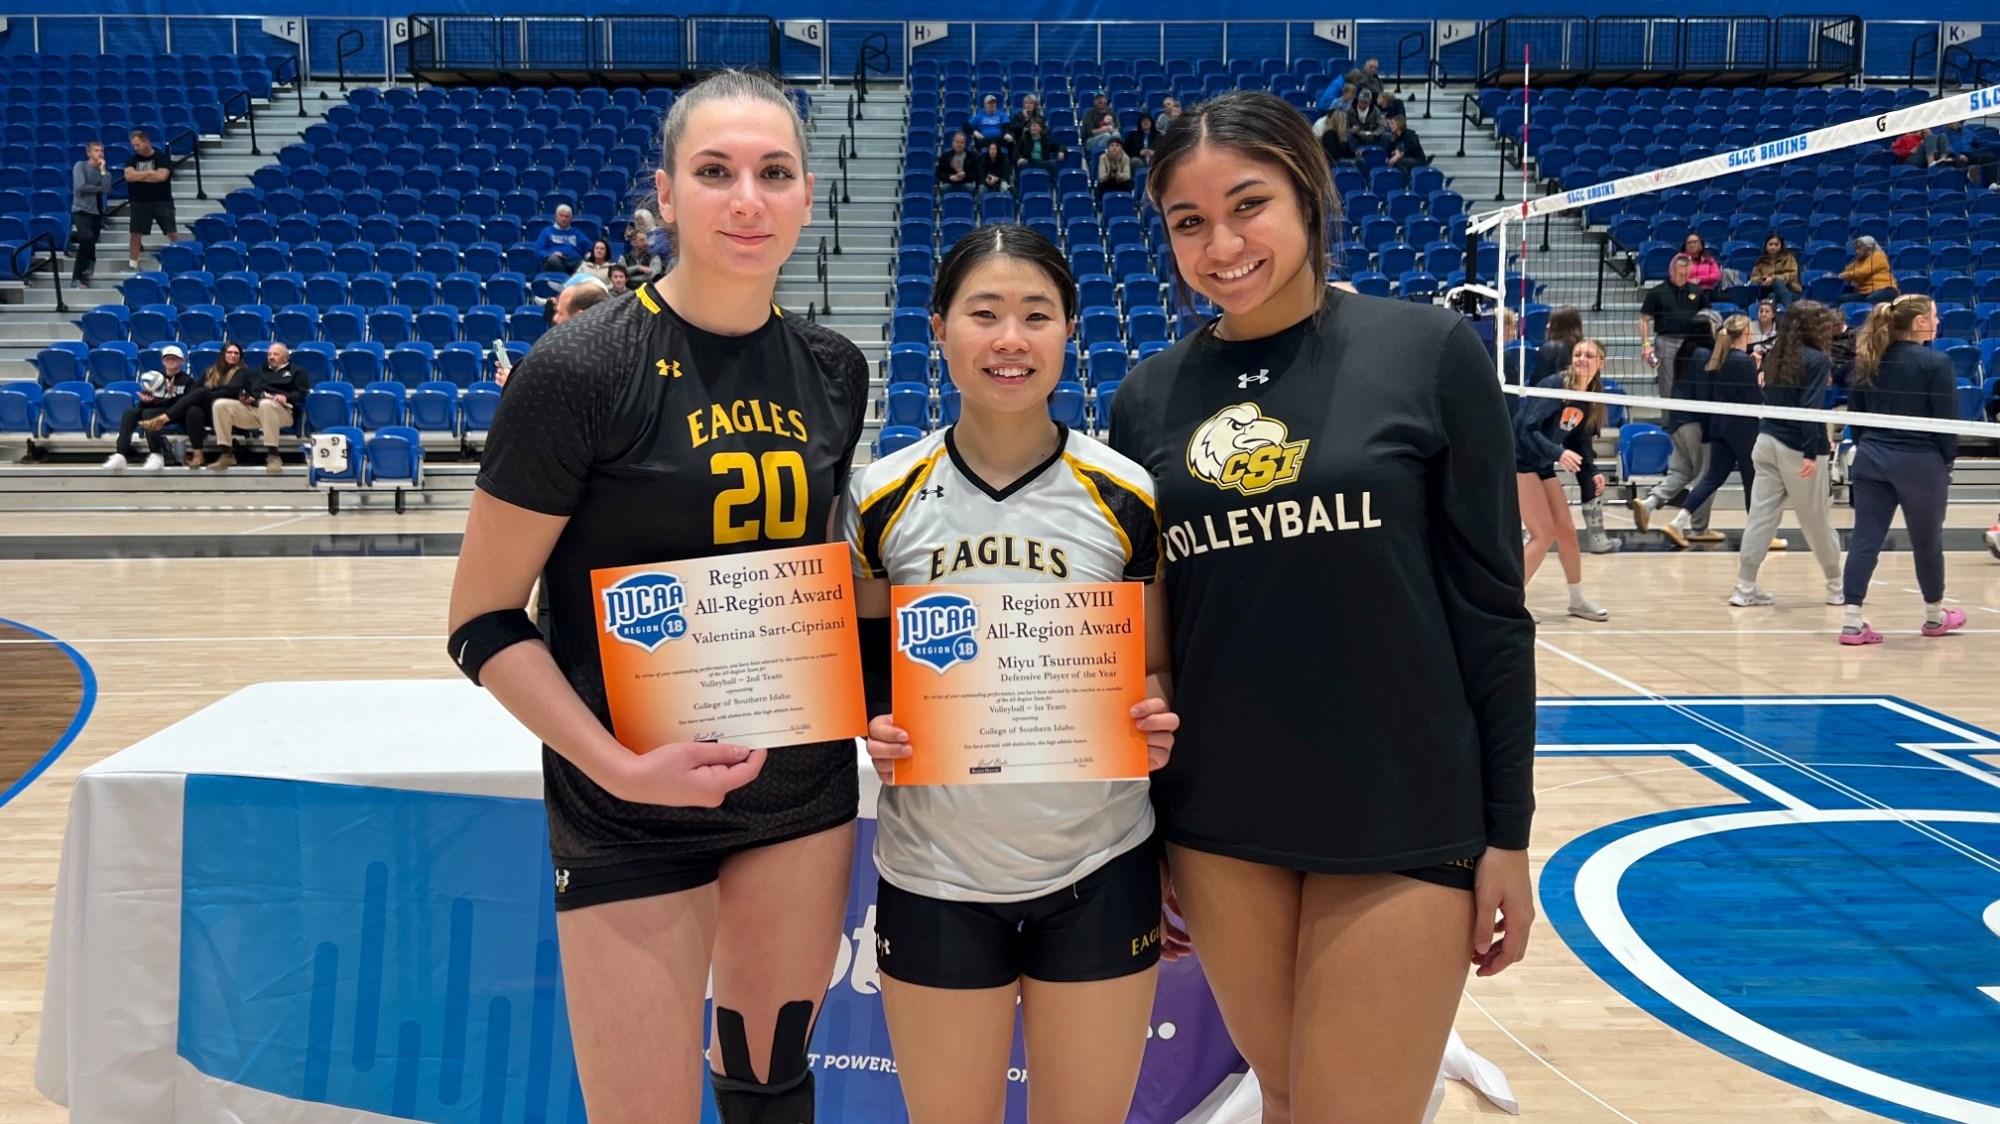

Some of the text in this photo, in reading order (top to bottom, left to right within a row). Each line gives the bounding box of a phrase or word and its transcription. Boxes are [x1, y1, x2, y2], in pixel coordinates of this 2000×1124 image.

[287, 21, 296, 36] F
[395, 22, 406, 37] G
[807, 24, 818, 40] G
[915, 25, 925, 41] H
[1336, 24, 1346, 40] H
[1443, 24, 1452, 40] J
[1950, 26, 1959, 41] K
[1728, 135, 1807, 167] SLCC BRUINS
[687, 400, 808, 449] EAGLES
[1220, 443, 1303, 490] CSI
[710, 450, 809, 545] 20
[929, 533, 1070, 583] EAGLES
[709, 558, 824, 588] Region XVIII
[605, 585, 684, 628] NJCAA
[694, 584, 843, 615] All-Region Award
[1002, 591, 1114, 615] Region XVIII
[624, 619, 684, 635] REGION 18
[692, 616, 845, 645] Valentina Sart-Cipriani
[901, 607, 976, 647] NJCAA
[986, 618, 1132, 643] All-Region Award
[916, 642, 975, 656] REGION 18
[998, 652, 1117, 672] Miyu Tsurumaki
[700, 678, 736, 688] Volleyball
[762, 672, 783, 681] Team
[1000, 669, 1118, 682] Defensive Player of the Year
[693, 701, 721, 710] College
[734, 696, 768, 705] Southern
[769, 693, 792, 702] Idaho
[990, 704, 1025, 714] Volleyball
[1046, 702, 1066, 710] Team
[979, 727, 1007, 736] College
[1019, 724, 1052, 734] Southern
[1054, 724, 1076, 732] Idaho
